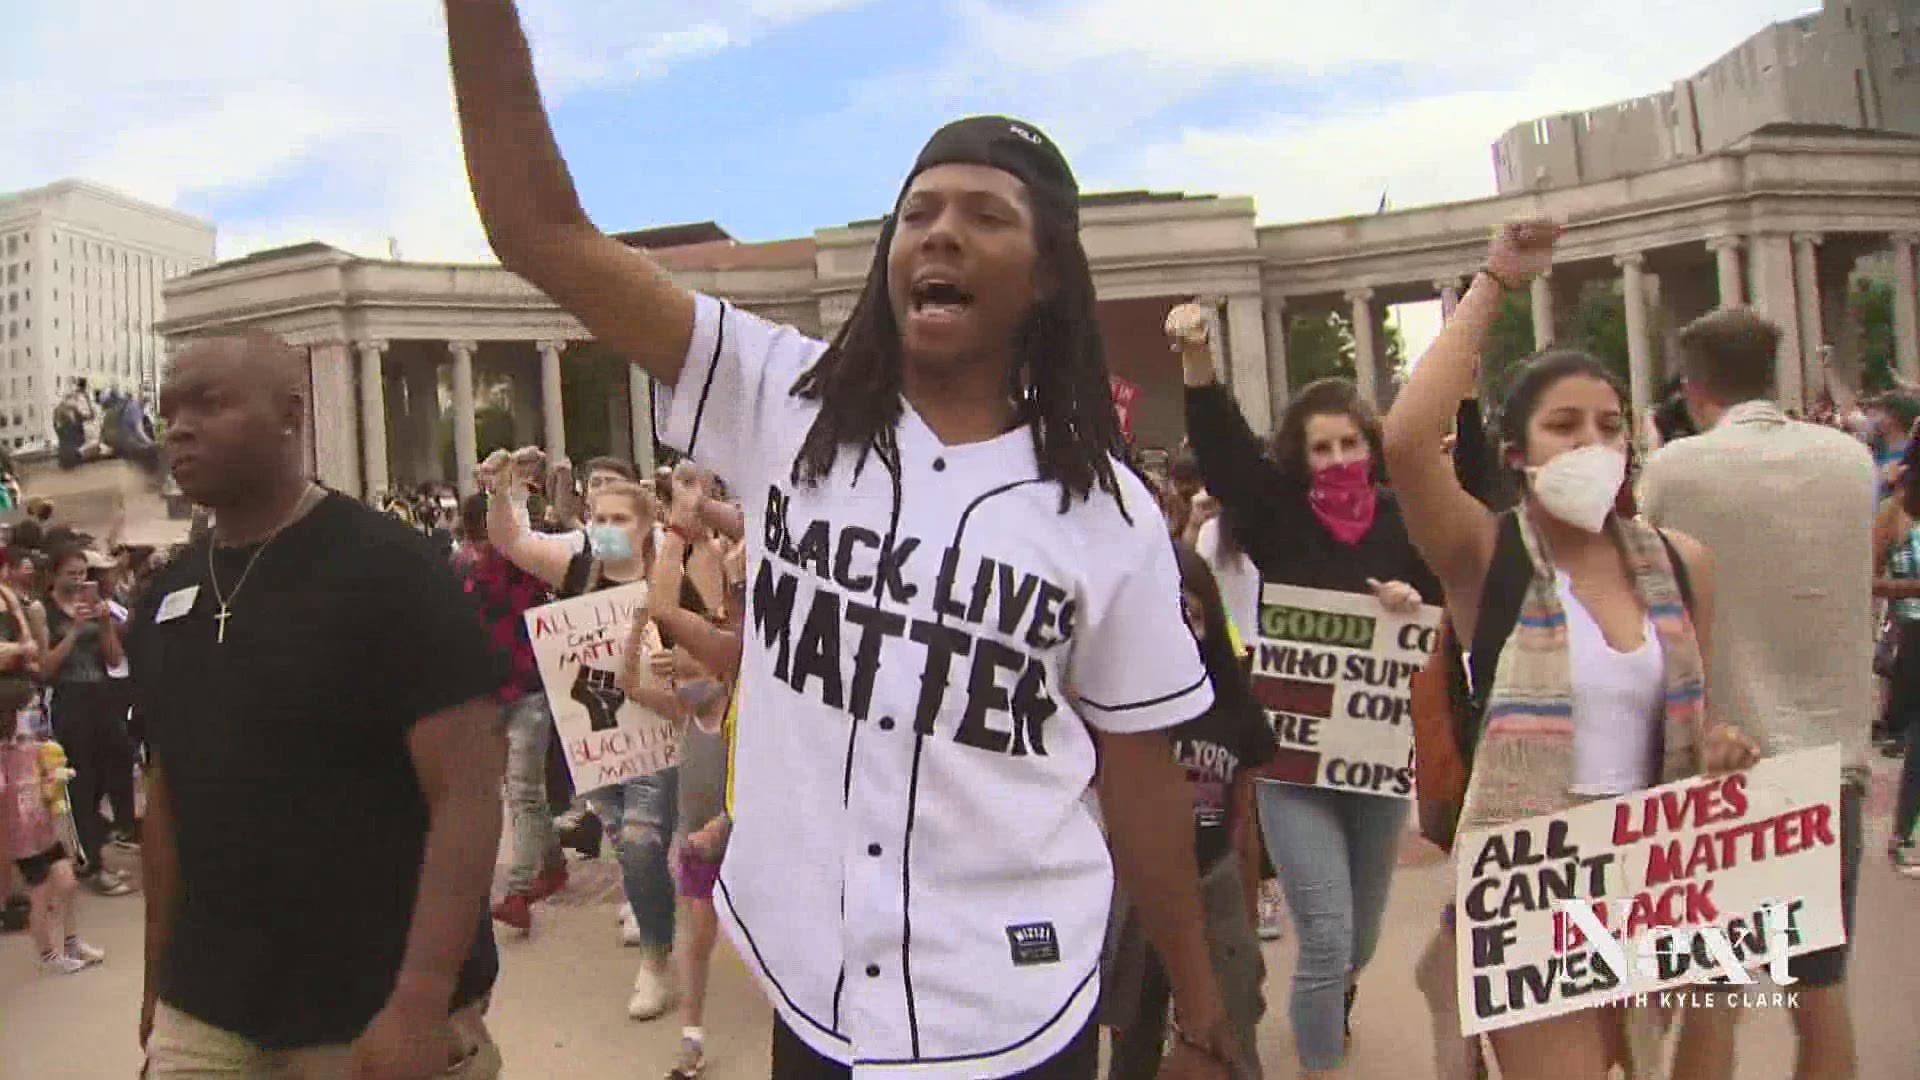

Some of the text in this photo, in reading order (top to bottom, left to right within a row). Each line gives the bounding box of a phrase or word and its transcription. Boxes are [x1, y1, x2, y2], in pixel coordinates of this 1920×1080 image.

[764, 485, 1077, 649] BLACK LIVES
[535, 608, 577, 639] ALL
[1261, 604, 1439, 653] GOOD CO
[558, 639, 624, 670] MATT
[753, 556, 1058, 756] MATTER
[1259, 644, 1337, 679] WHO
[1347, 691, 1411, 725] COP
[1326, 758, 1412, 795] COPS
[1472, 772, 1748, 878] ALL LIVES
[1645, 803, 1835, 887] MATTER
[1471, 921, 1518, 968] IF
[1472, 951, 1620, 1019] LIVES
